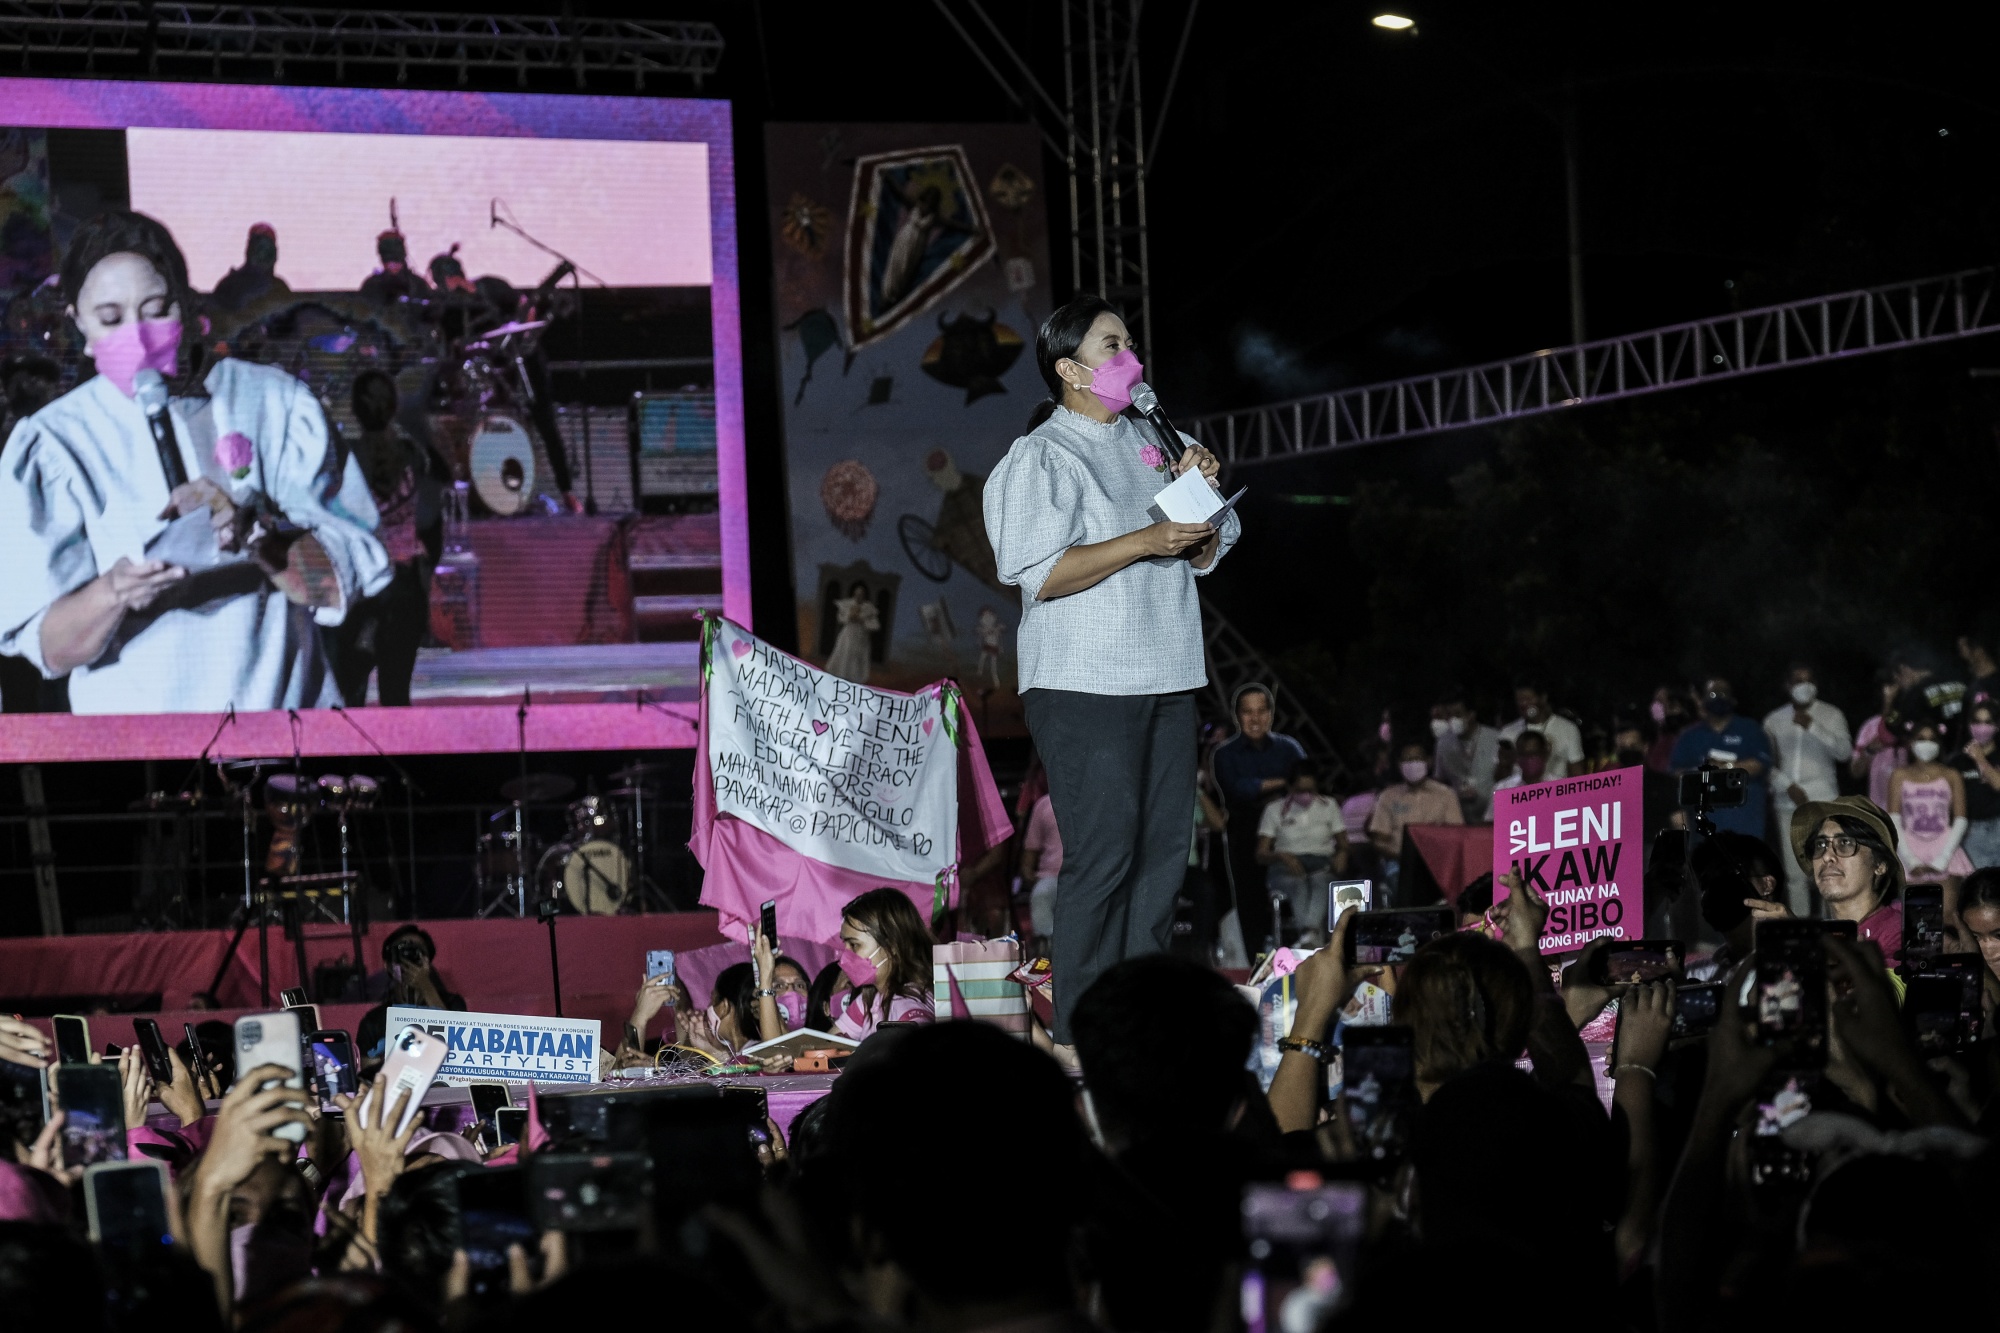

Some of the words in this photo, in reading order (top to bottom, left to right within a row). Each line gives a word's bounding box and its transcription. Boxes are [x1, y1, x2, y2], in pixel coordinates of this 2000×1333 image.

[750, 638, 824, 694] HAPPY
[831, 680, 932, 723] BIRTHDAY
[737, 663, 809, 710] MADAM
[817, 698, 849, 721] VP
[857, 712, 920, 745] LENI
[734, 704, 818, 761] FINANCIAL
[825, 747, 917, 787] LITERACY
[862, 739, 887, 764] FR.
[893, 746, 925, 767] THE
[715, 752, 769, 786] MAHAL
[772, 771, 828, 803] NAMING
[754, 738, 874, 797] EDUCATORS
[1511, 786, 1553, 805] HAPPY
[1556, 774, 1622, 797] BIRTHDAY!
[714, 775, 794, 823] PAYAKAP
[911, 832, 932, 856] PO
[1528, 801, 1621, 854] LENI
[1509, 819, 1527, 855] VP
[1512, 842, 1622, 892] KAW
[1545, 886, 1595, 907] TUNAY
[1598, 882, 1620, 899] NA
[1541, 898, 1623, 936] SIBO
[1538, 934, 1572, 950] UONG
[447, 1025, 593, 1059] KABATAAN
[440, 1066, 464, 1074] ASYON,
[507, 1070, 538, 1078] TRABAHO,
[446, 1052, 592, 1072] PARTYLIST
